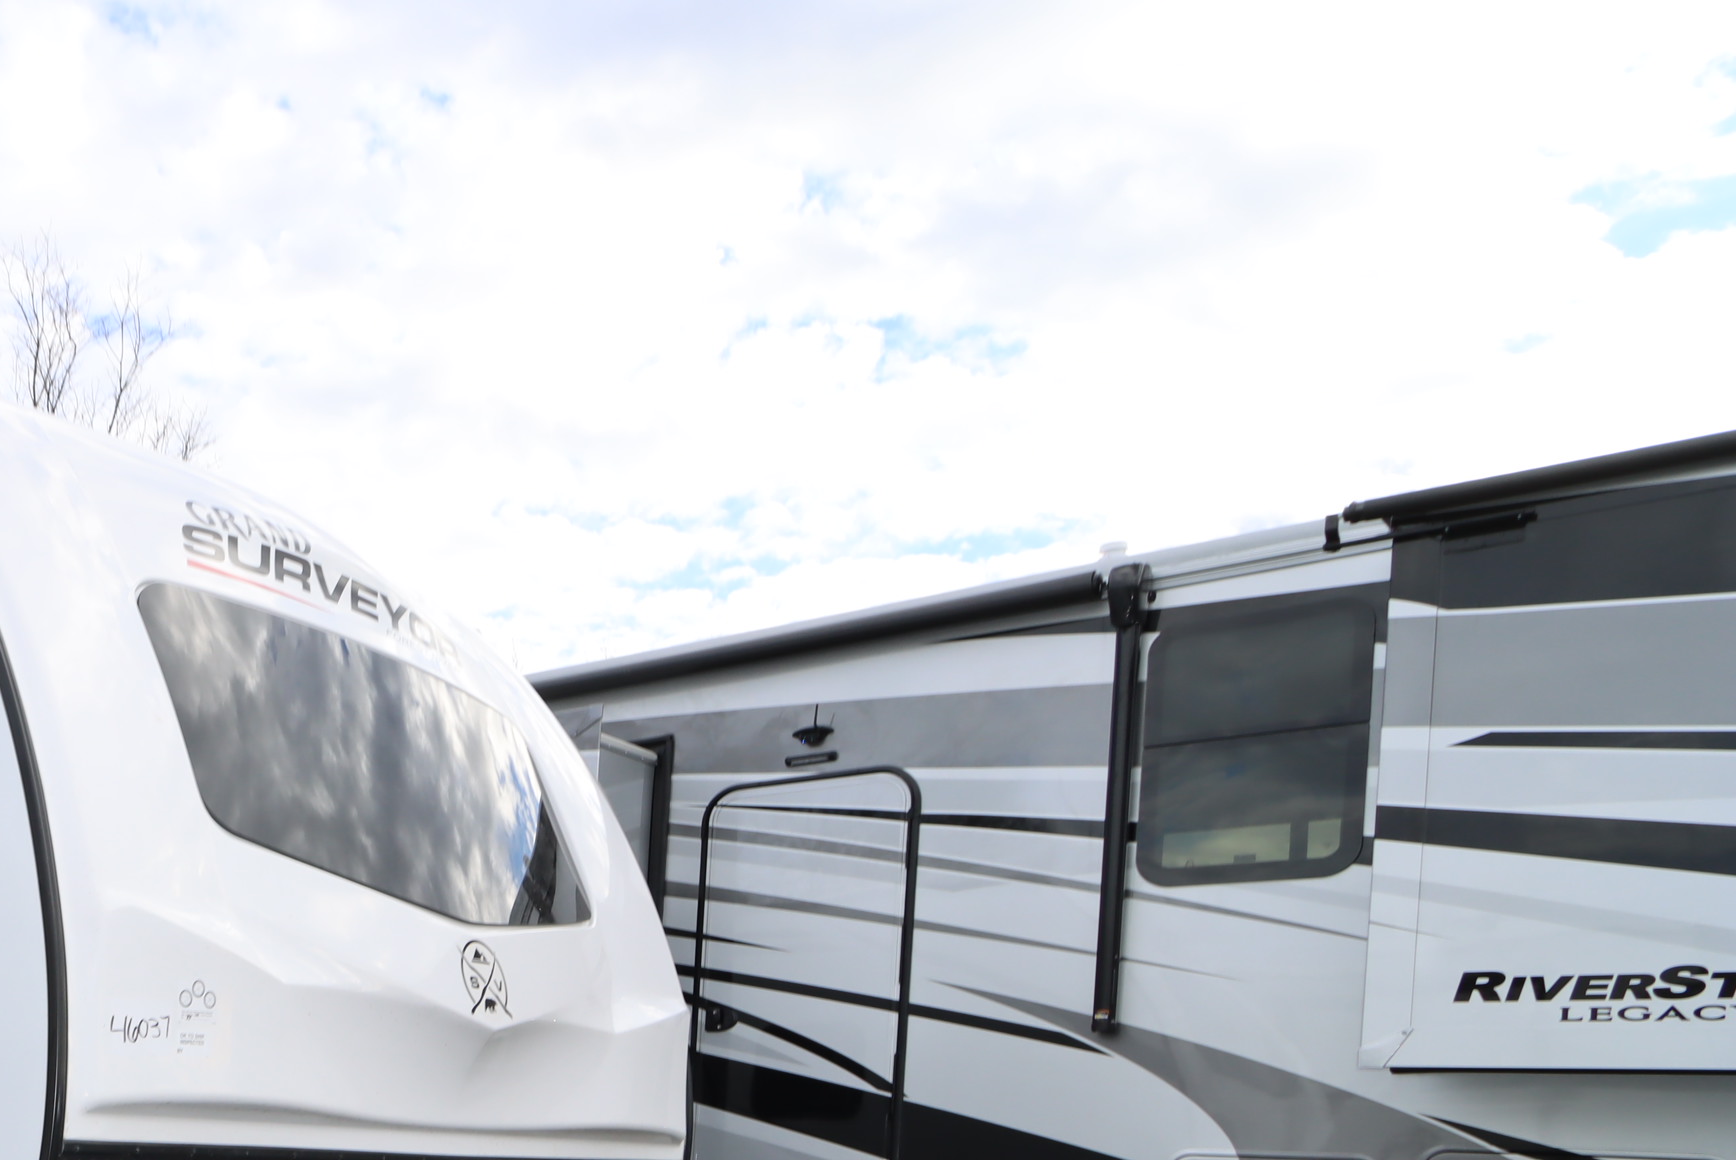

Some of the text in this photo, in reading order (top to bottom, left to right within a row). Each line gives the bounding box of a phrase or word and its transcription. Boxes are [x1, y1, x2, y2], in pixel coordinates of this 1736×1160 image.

[185, 500, 312, 556] GRAND
[1559, 1005, 1736, 1023] LEGAC
[110, 1015, 170, 1043] 46037
